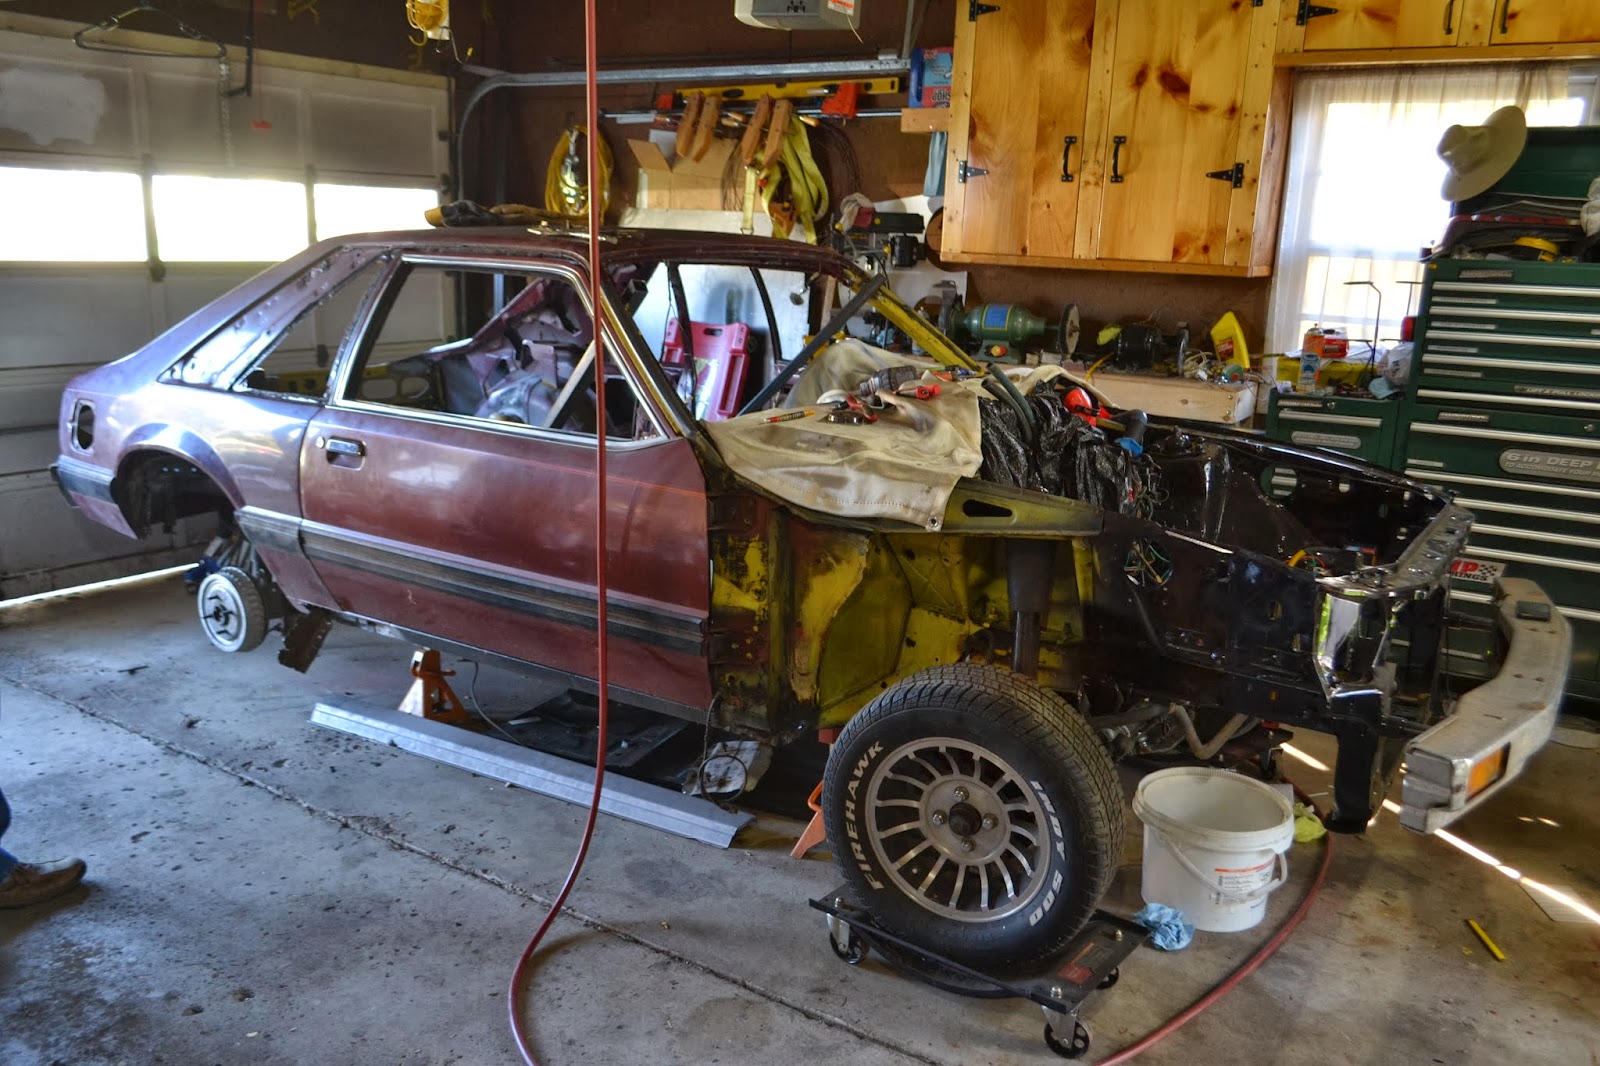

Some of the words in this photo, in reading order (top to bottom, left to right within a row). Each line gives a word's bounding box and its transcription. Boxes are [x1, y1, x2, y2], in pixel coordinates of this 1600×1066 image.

[1506, 453, 1522, 461] 6
[1523, 454, 1541, 464] in
[1546, 456, 1593, 468] DEEP
[1569, 468, 1591, 476] YOUR
[845, 740, 885, 890] FIREHAWK
[1030, 780, 1066, 861] INDY
[1029, 869, 1064, 927] 500
